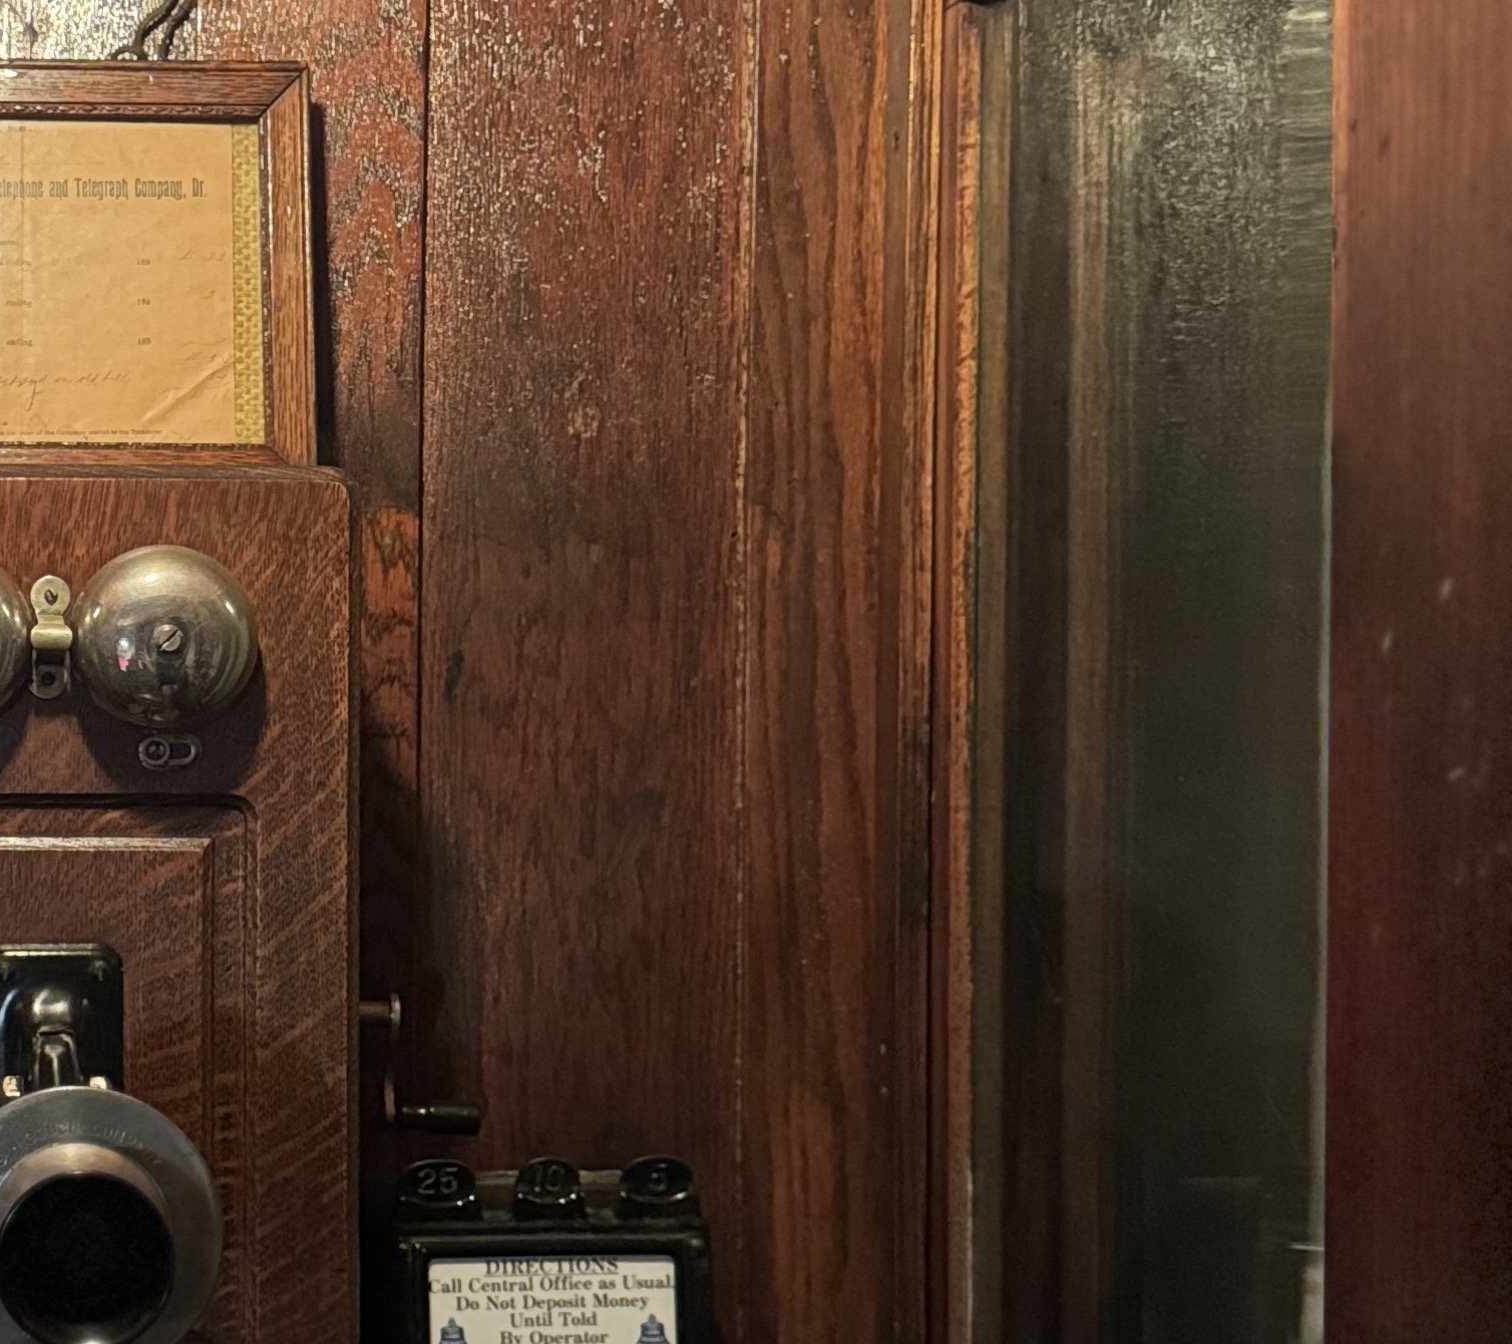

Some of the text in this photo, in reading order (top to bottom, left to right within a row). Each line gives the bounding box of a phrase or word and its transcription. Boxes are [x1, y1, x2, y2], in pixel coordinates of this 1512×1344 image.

[48, 178, 69, 198] and
[74, 177, 129, 201] Telegraph
[417, 1167, 458, 1194] 25
[534, 1164, 565, 1192] 10
[484, 1257, 619, 1276] DIRECTIONS
[469, 1276, 534, 1293] Central
[539, 1275, 593, 1291] Office
[598, 1279, 616, 1290] as
[456, 1292, 649, 1312] Do Not Deposit Money
[510, 1310, 598, 1328] Until Told
